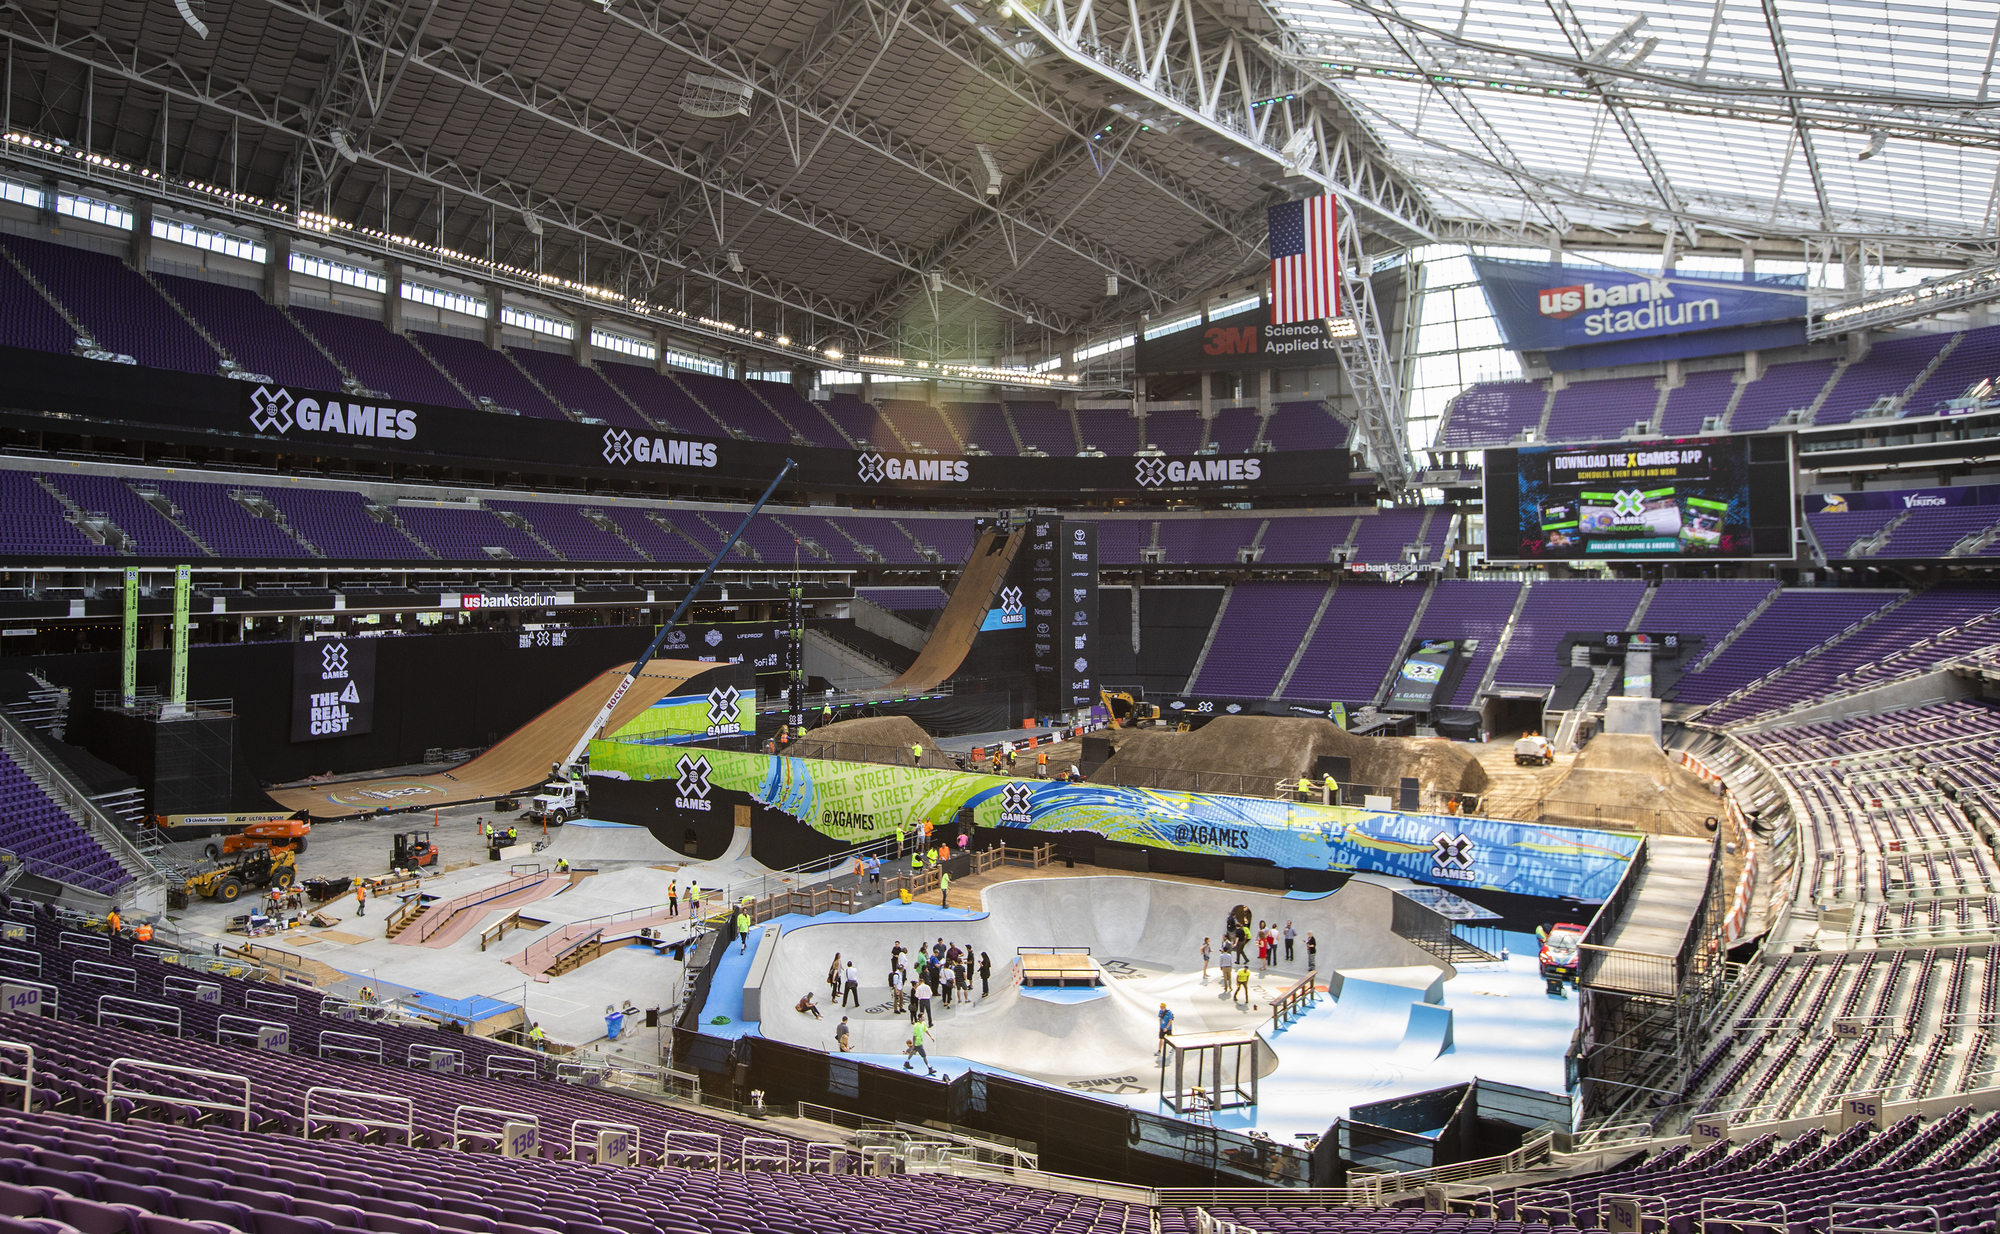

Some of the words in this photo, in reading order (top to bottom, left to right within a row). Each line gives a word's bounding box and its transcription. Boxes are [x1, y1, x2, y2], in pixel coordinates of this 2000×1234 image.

[1584, 298, 1720, 336] stadium
[1265, 324, 1322, 337] Science.
[1203, 326, 1257, 355] 3M
[1265, 338, 1318, 354] Applied
[1322, 338, 1335, 349] to
[296, 398, 418, 440] GAMES
[633, 436, 718, 468] GAMES
[1555, 454, 1607, 469] DOWNLOAD
[1608, 454, 1626, 467] THE
[1680, 450, 1702, 464] APP
[886, 458, 969, 482] GAMES
[1167, 458, 1261, 482] GAMES
[1613, 516, 1646, 524] GAMES
[1002, 614, 1023, 624] GAMES
[754, 659, 768, 667] SoFi
[322, 670, 348, 679] GAMES
[310, 692, 338, 707] THE
[606, 678, 630, 710] ROCKET
[311, 705, 349, 721] REAL
[640, 710, 654, 722] BIG
[657, 709, 670, 720] AIR
[675, 708, 689, 719] BIG
[692, 706, 705, 717] AIR
[1290, 706, 1325, 715] LIFEPROOF
[627, 725, 639, 736] AIR
[645, 724, 659, 734] BIG
[662, 721, 676, 732] AIR
[680, 719, 693, 730] BIG
[706, 723, 740, 736] GAMES
[591, 754, 621, 770] STREET
[626, 746, 658, 766] STREET
[712, 759, 747, 780] STREET
[855, 767, 896, 792] STREET
[675, 797, 712, 812] GAMES
[824, 795, 864, 814] STREET
[872, 784, 913, 809] STREET
[822, 810, 874, 830] @XGAMES
[1001, 812, 1032, 823] GAMES
[1175, 824, 1248, 850] @XGAMES
[1381, 816, 1431, 845] PARK
[1458, 820, 1513, 846] PARK
[1432, 868, 1475, 882] GAMES
[1502, 854, 1558, 888] PARK
[6, 928, 24, 939] 142
[8, 990, 38, 1009] 140
[202, 990, 218, 1001] 141
[342, 1010, 356, 1019] 141
[1837, 1024, 1857, 1035] 134
[264, 1032, 287, 1050] 140
[435, 1055, 452, 1069] 140
[586, 1074, 599, 1086] 140
[1067, 1076, 1138, 1088] GAMES
[1850, 1101, 1876, 1116] 136
[1697, 1124, 1721, 1138] 136
[512, 1129, 535, 1156] 138
[607, 1135, 626, 1159] 138
[1427, 1191, 1439, 1209] 138
[1613, 1204, 1632, 1228] 138
